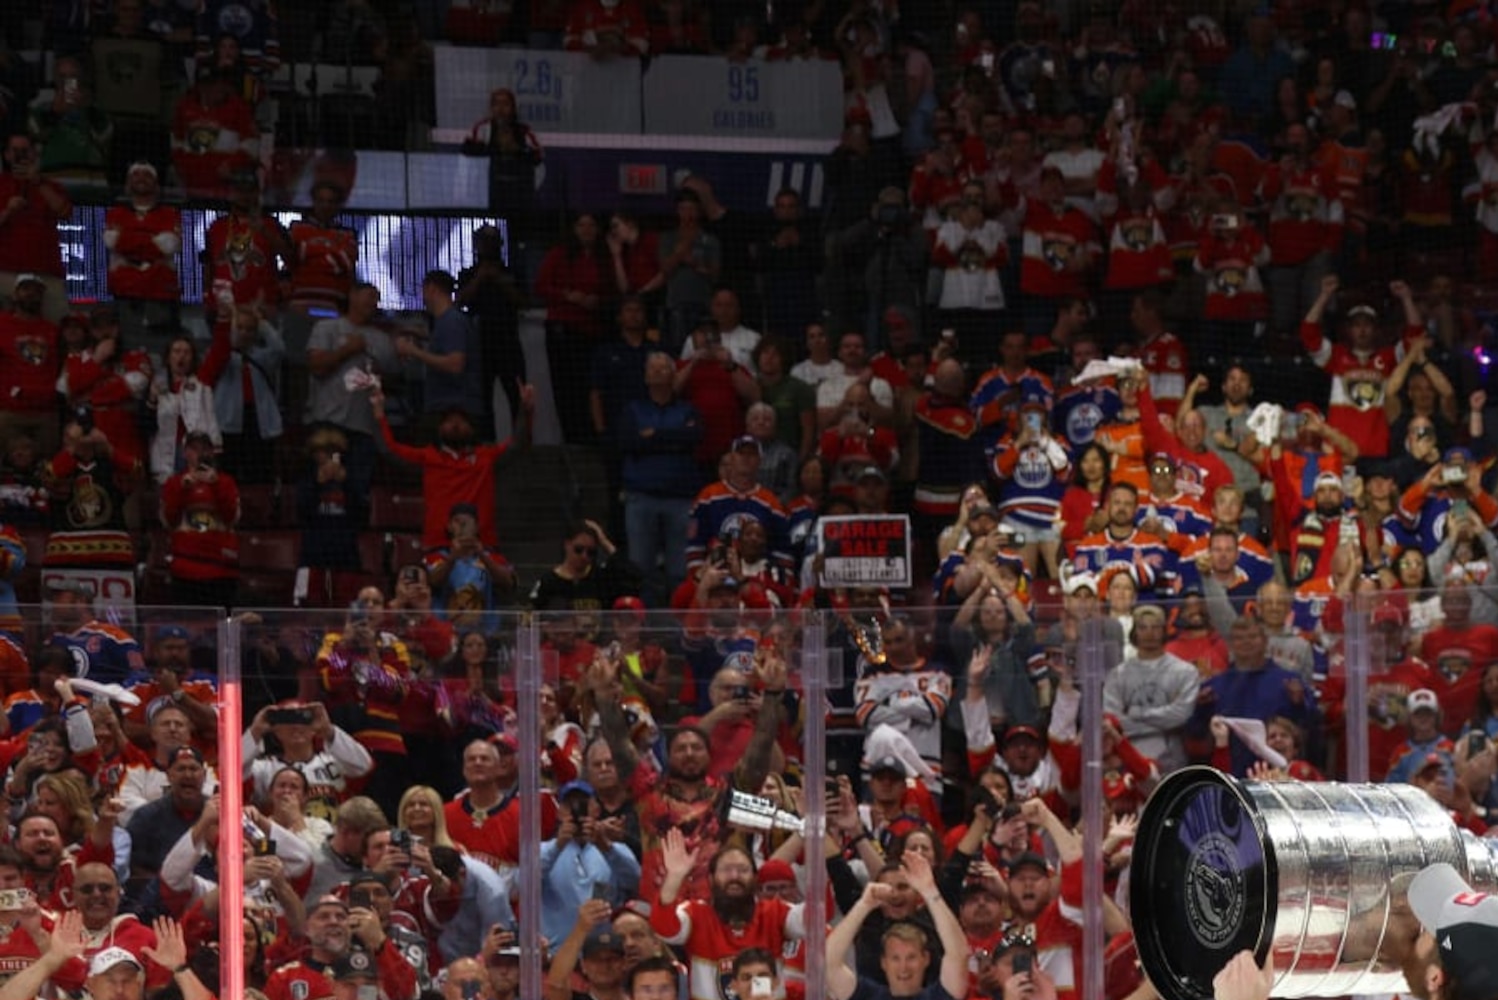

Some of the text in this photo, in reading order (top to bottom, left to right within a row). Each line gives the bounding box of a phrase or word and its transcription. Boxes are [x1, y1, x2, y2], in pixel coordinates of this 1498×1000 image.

[728, 66, 760, 103] 95
[825, 521, 904, 539] GARAGE
[840, 540, 889, 556] SALE
